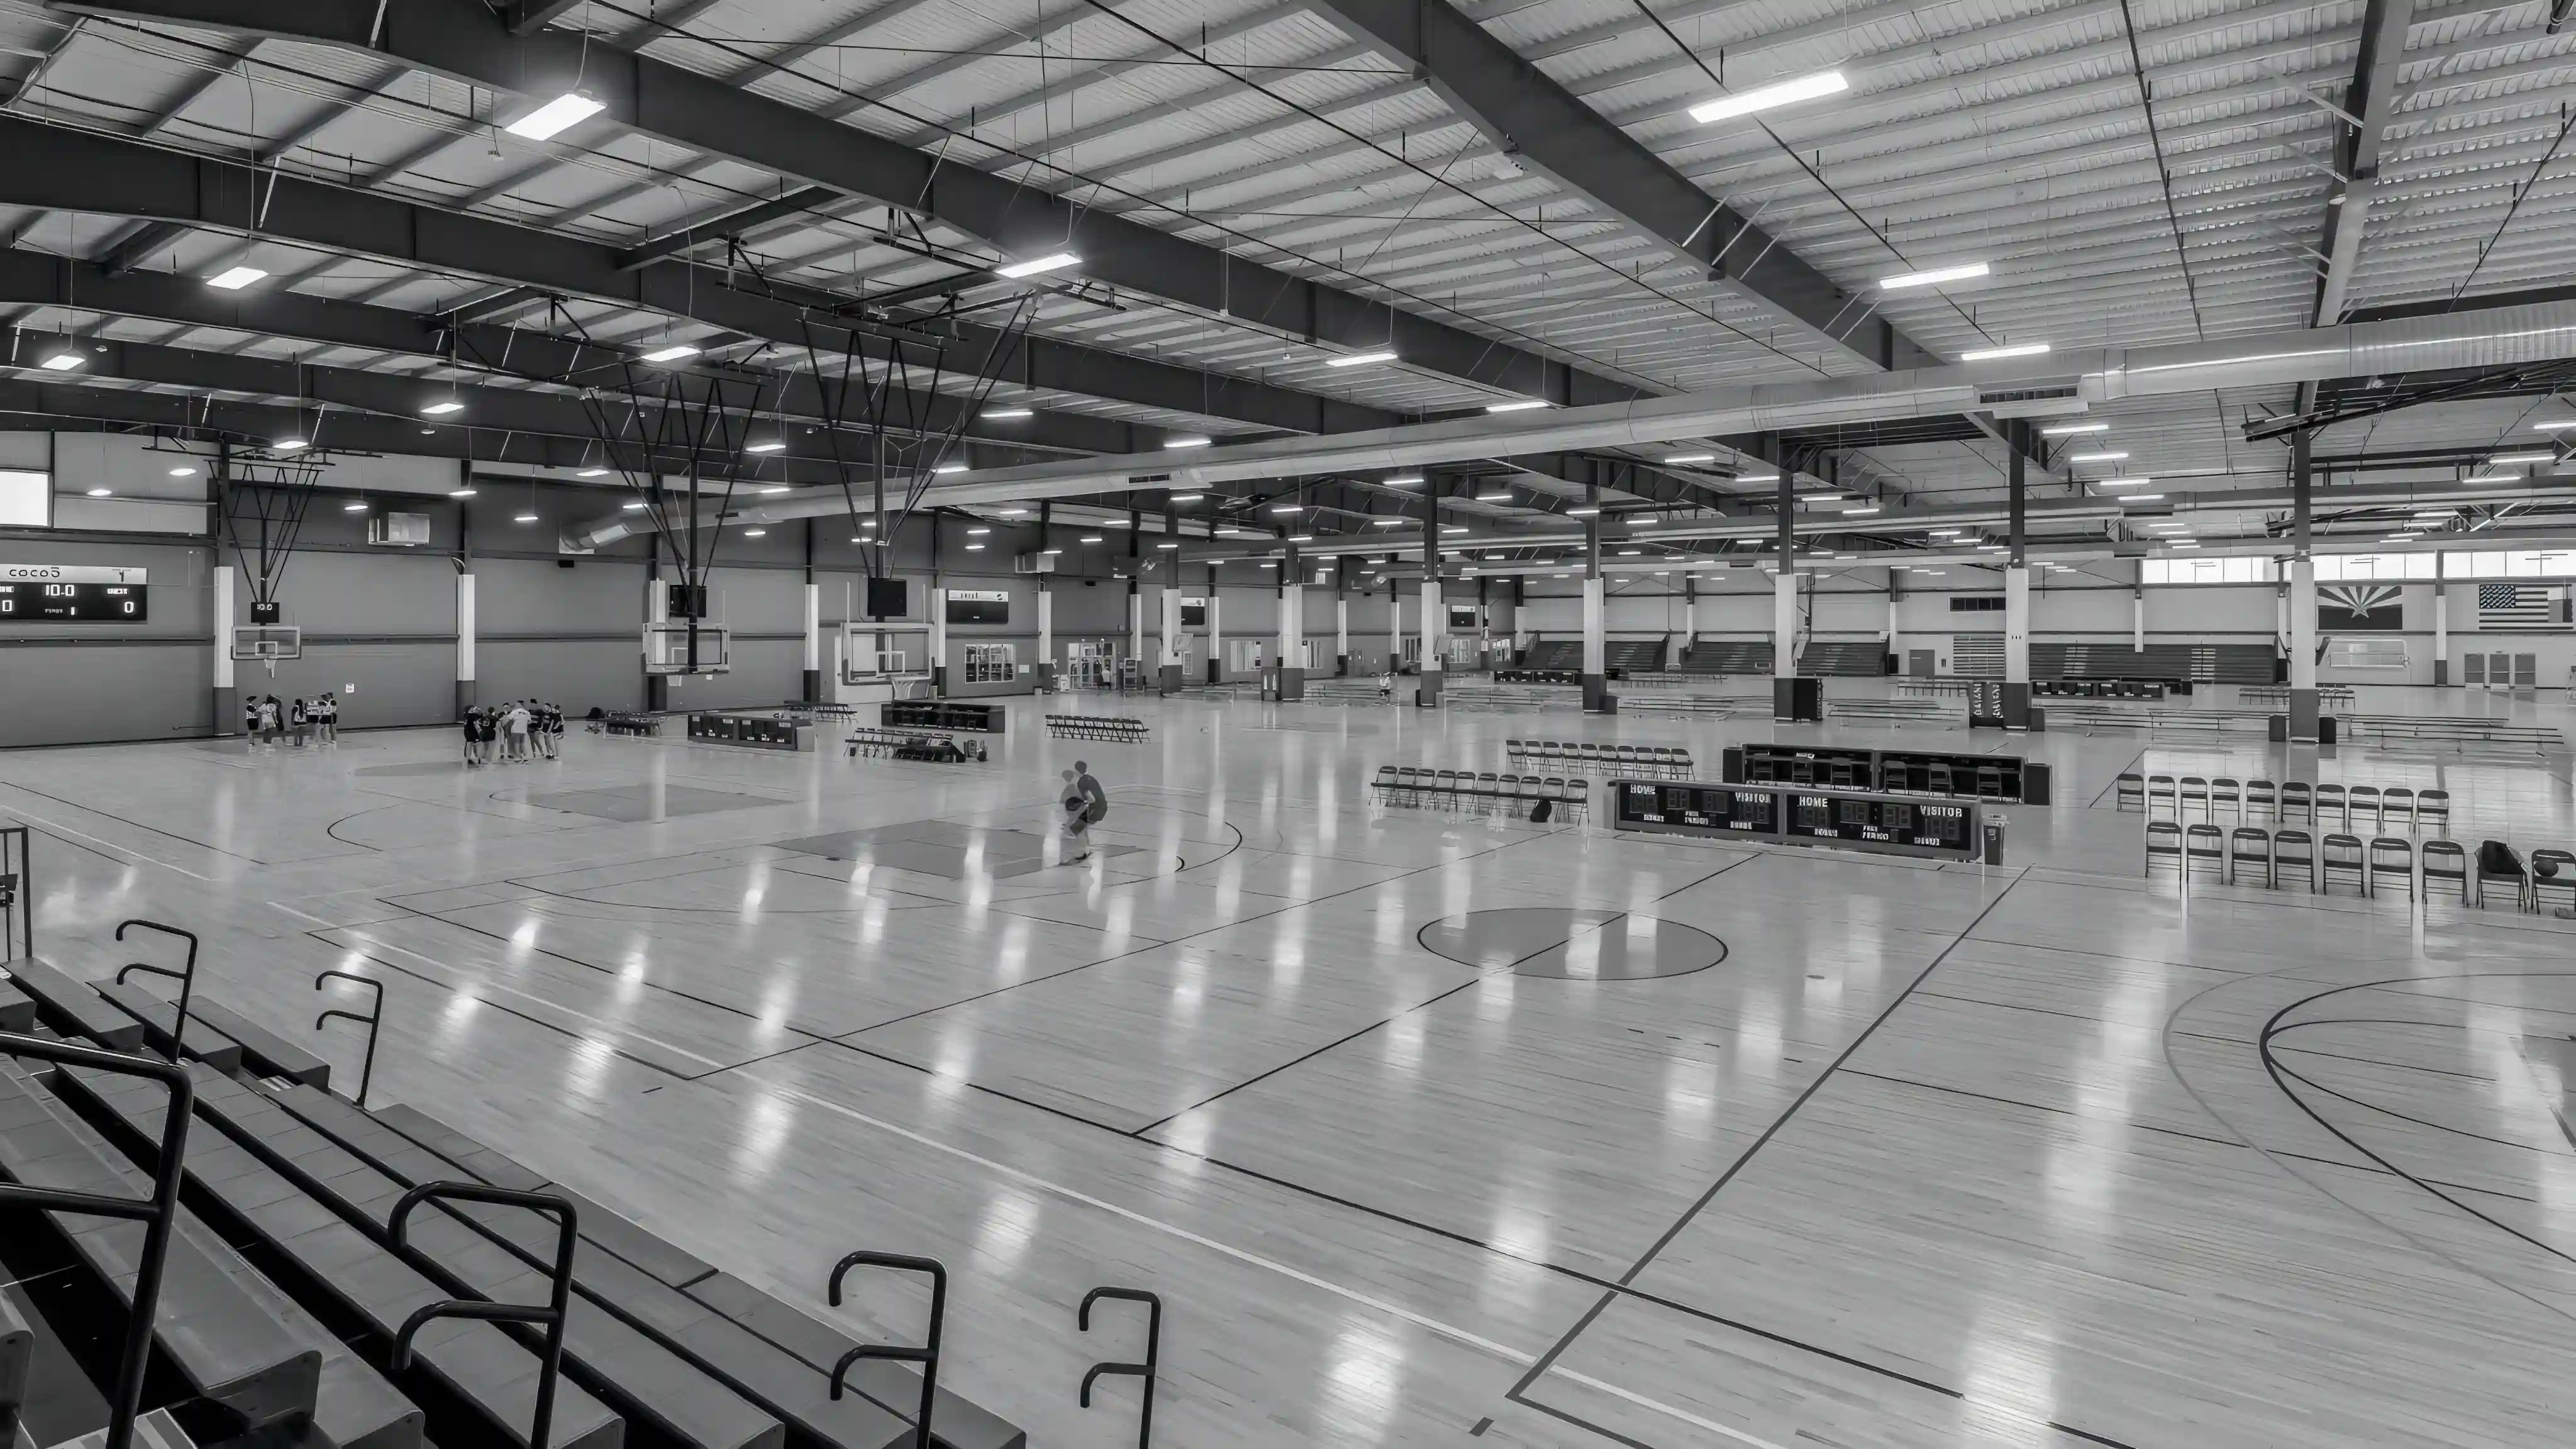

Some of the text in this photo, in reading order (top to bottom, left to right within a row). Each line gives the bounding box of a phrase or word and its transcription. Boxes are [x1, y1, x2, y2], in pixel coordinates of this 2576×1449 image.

[45, 584, 75, 596] 10.0
[2, 600, 13, 612] 0
[124, 601, 134, 613] 0
[1799, 796, 1829, 808] HOME
[1919, 804, 1963, 817] VISITOR
